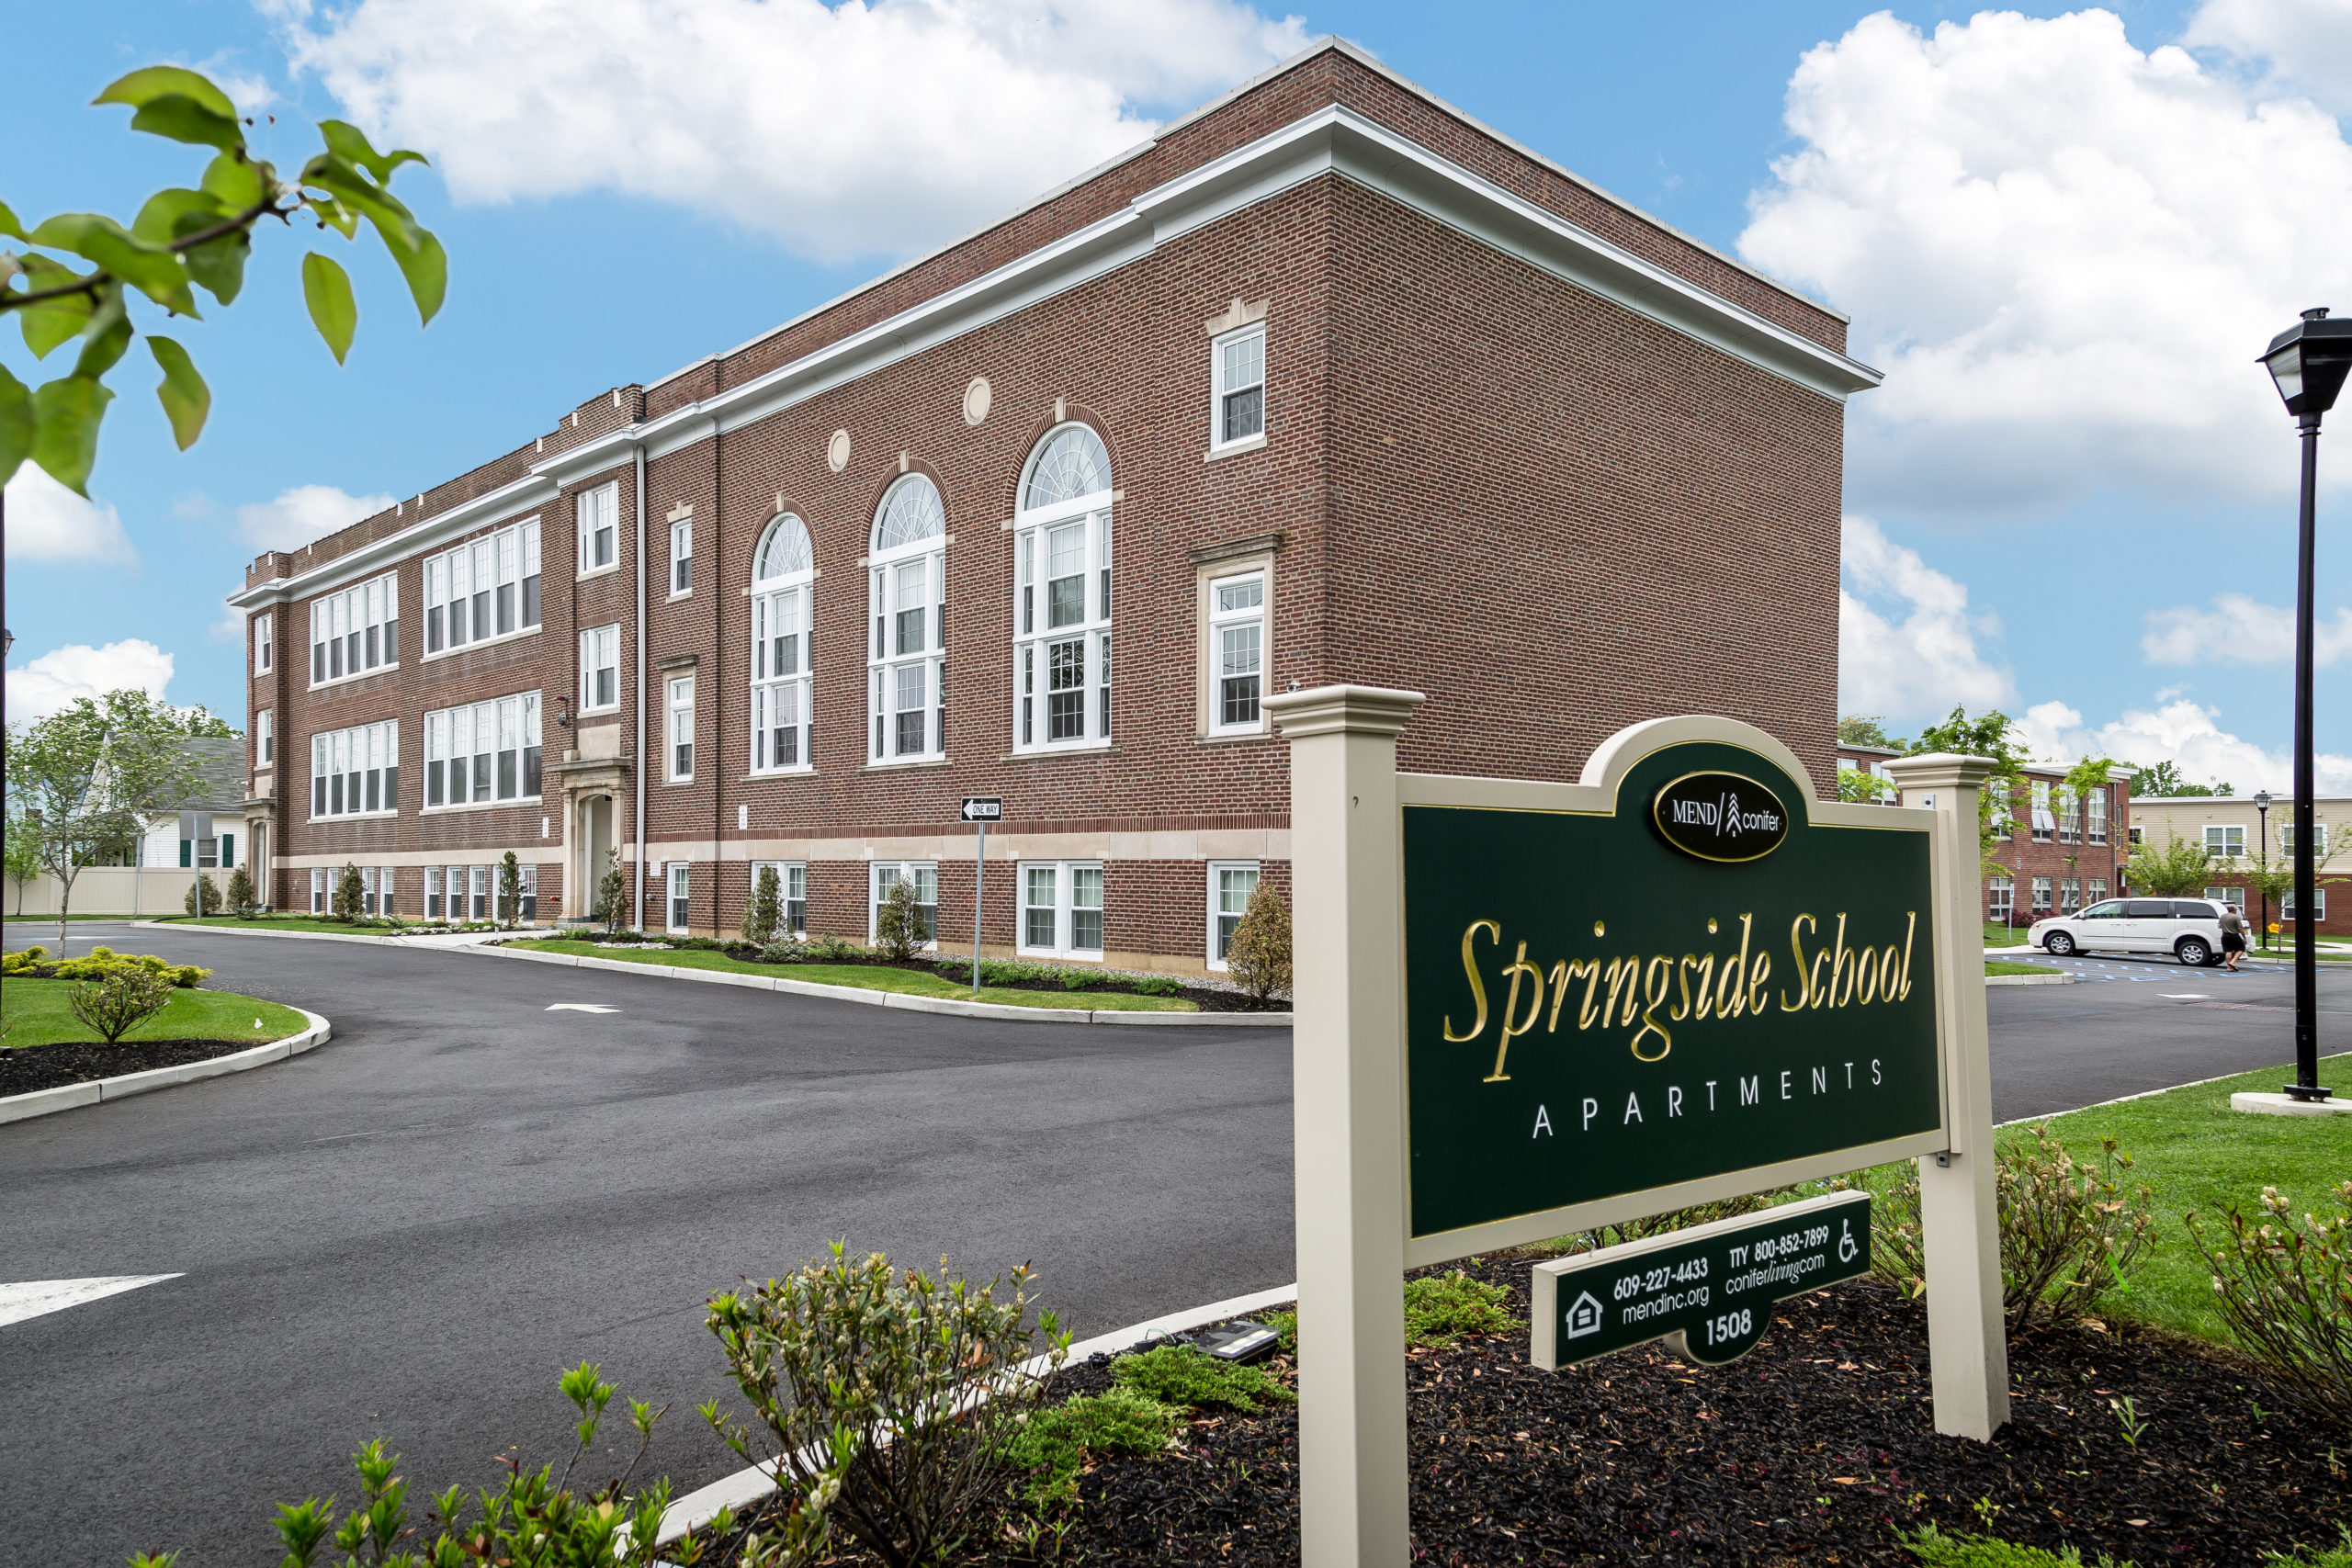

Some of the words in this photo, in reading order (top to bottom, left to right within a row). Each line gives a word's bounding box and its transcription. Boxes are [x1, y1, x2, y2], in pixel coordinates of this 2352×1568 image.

[973, 805, 984, 814] ONE
[986, 805, 998, 814] WAY
[1743, 810, 1780, 831] conifer
[1444, 912, 1771, 1083] Springside
[1781, 910, 1917, 1012] School
[1532, 1058, 1883, 1139] APARTMENTS
[1729, 1245, 1749, 1269] TTY
[1754, 1224, 1829, 1262] 800-852-7899
[1613, 1257, 1708, 1301] 609-227-4433
[1623, 1286, 1710, 1325] mendinc.org
[1706, 1308, 1752, 1346] 1508
